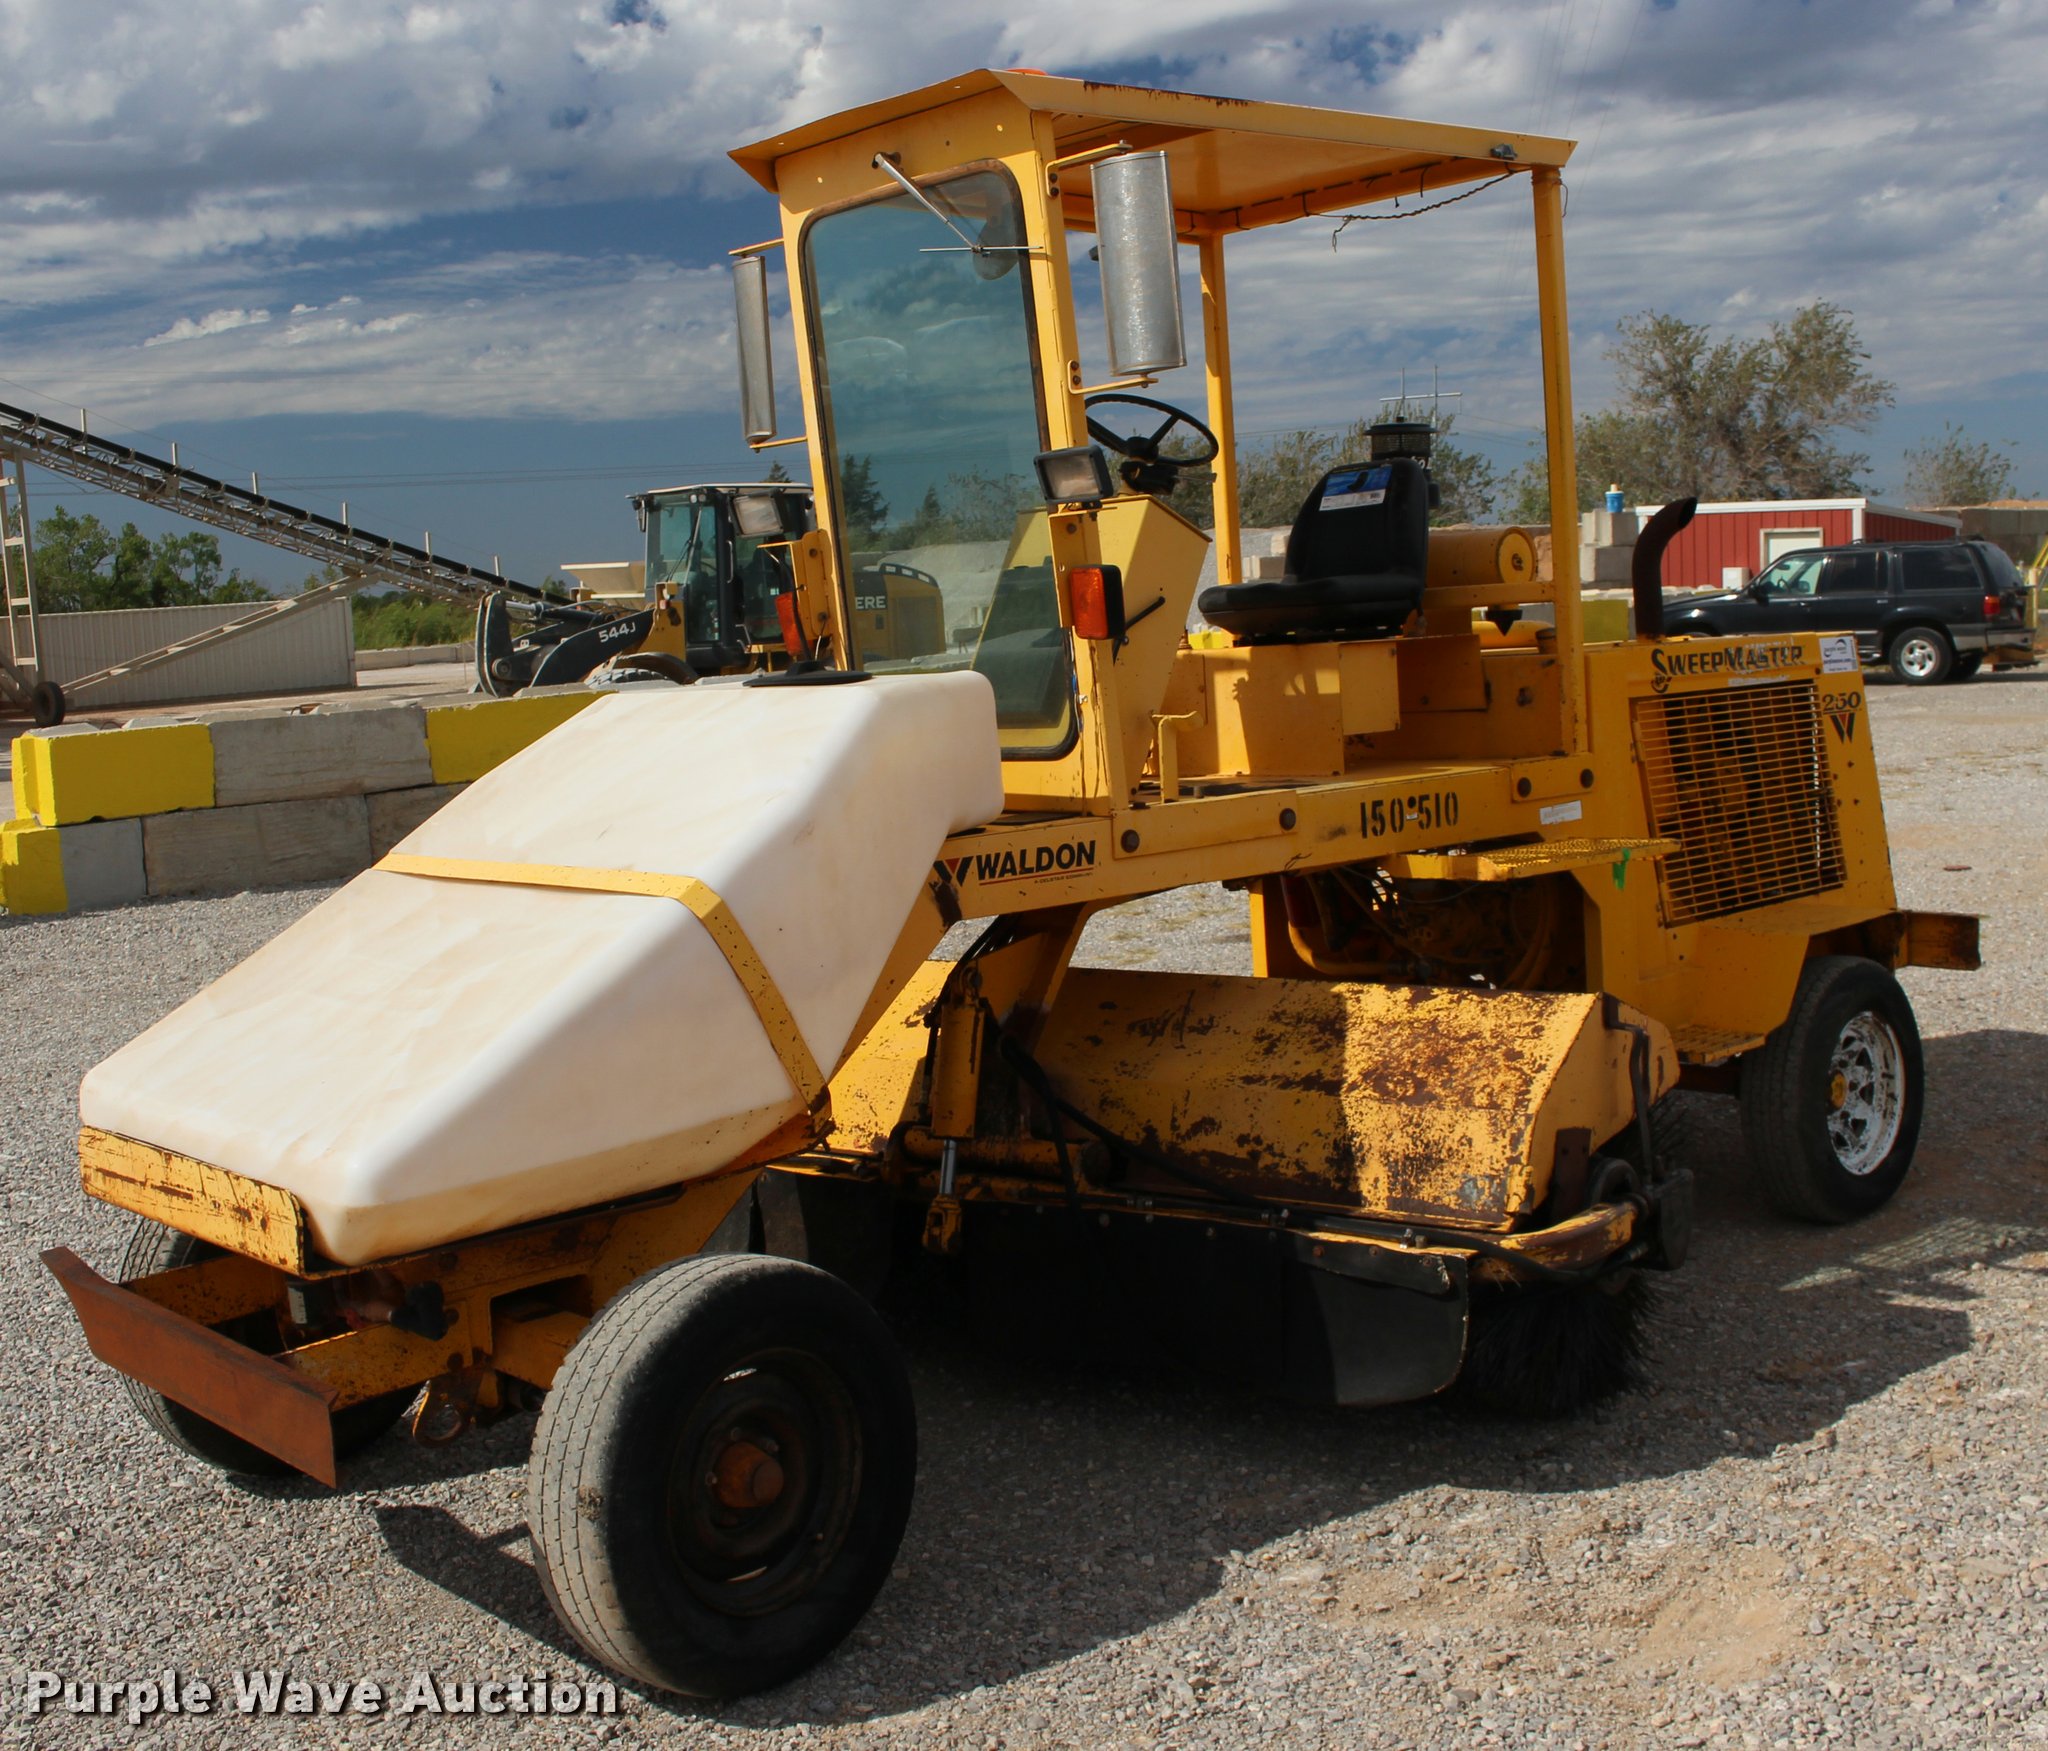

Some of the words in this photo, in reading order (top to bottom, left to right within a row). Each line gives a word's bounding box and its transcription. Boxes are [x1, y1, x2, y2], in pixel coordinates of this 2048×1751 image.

[854, 595, 887, 610] ERE
[598, 621, 636, 643] 544J
[1822, 690, 1862, 712] 250
[976, 839, 1096, 881] WALDON
